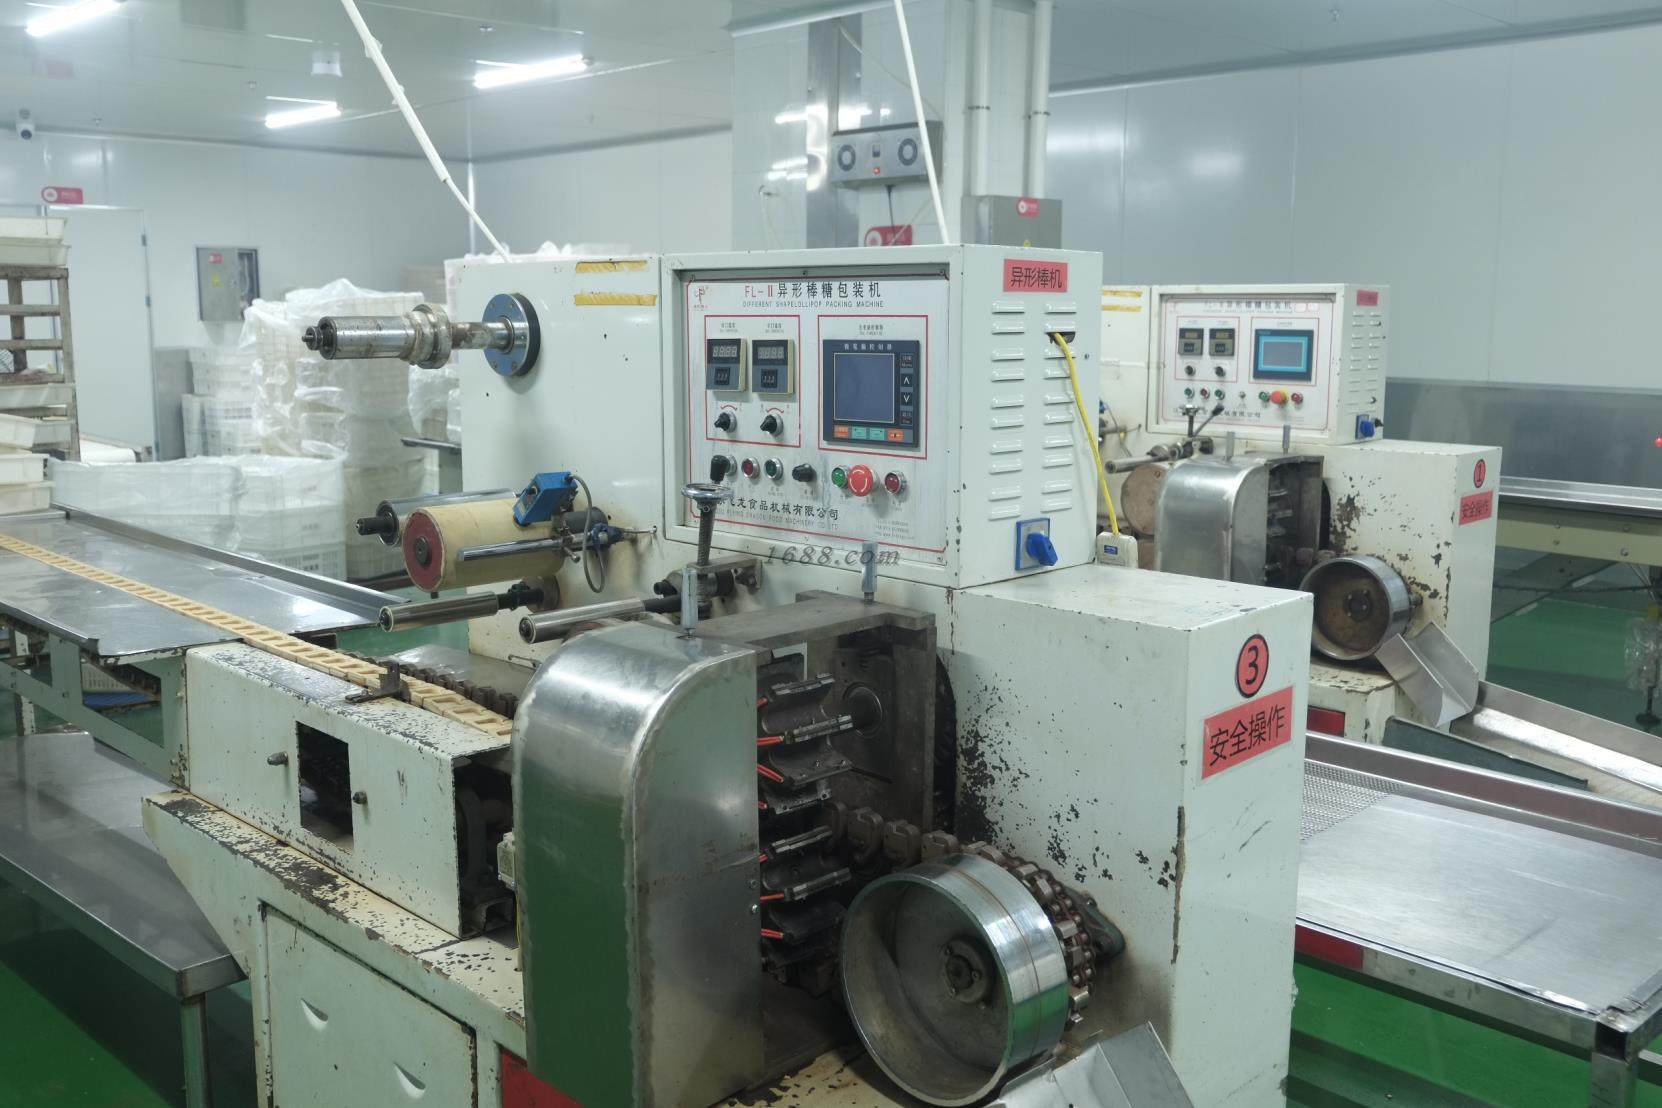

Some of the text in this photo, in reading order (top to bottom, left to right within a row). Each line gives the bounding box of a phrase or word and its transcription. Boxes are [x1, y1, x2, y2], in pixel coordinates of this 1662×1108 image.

[1011, 266, 1062, 289] 异形棒机
[825, 300, 853, 308] PACKING
[856, 300, 884, 308] MACHINE
[1209, 703, 1286, 767] 安全操作
